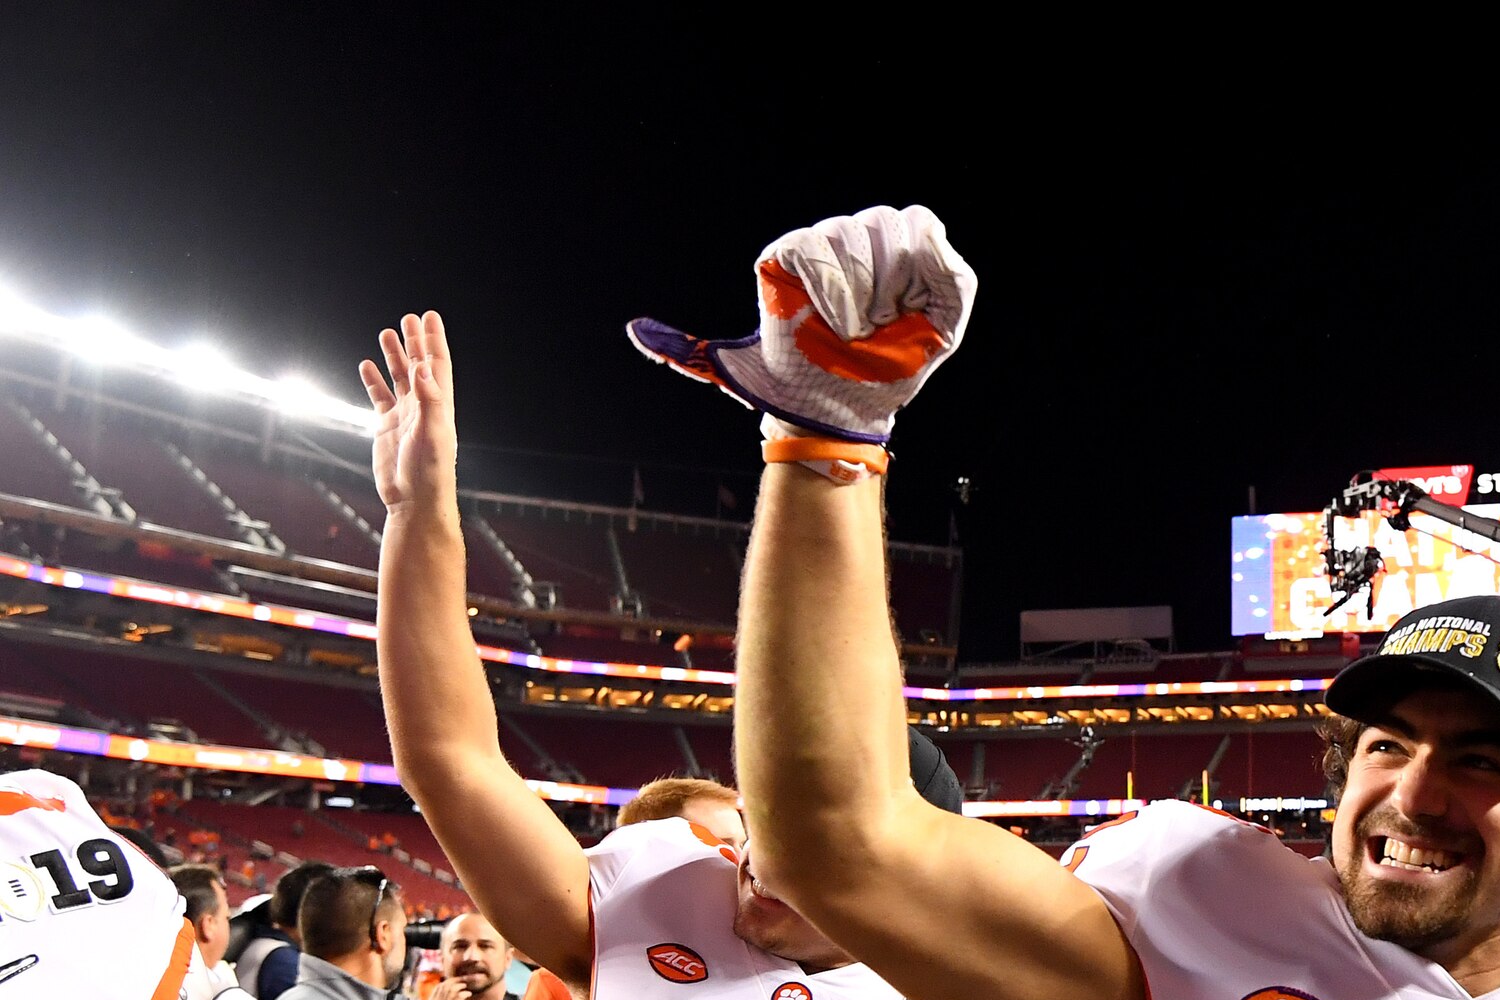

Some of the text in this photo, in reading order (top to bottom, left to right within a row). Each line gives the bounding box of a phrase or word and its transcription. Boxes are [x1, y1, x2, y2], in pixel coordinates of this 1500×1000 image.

[1415, 616, 1492, 637] NATIONAL
[1380, 628, 1488, 658] CHAMPS
[653, 951, 703, 976] ACC
